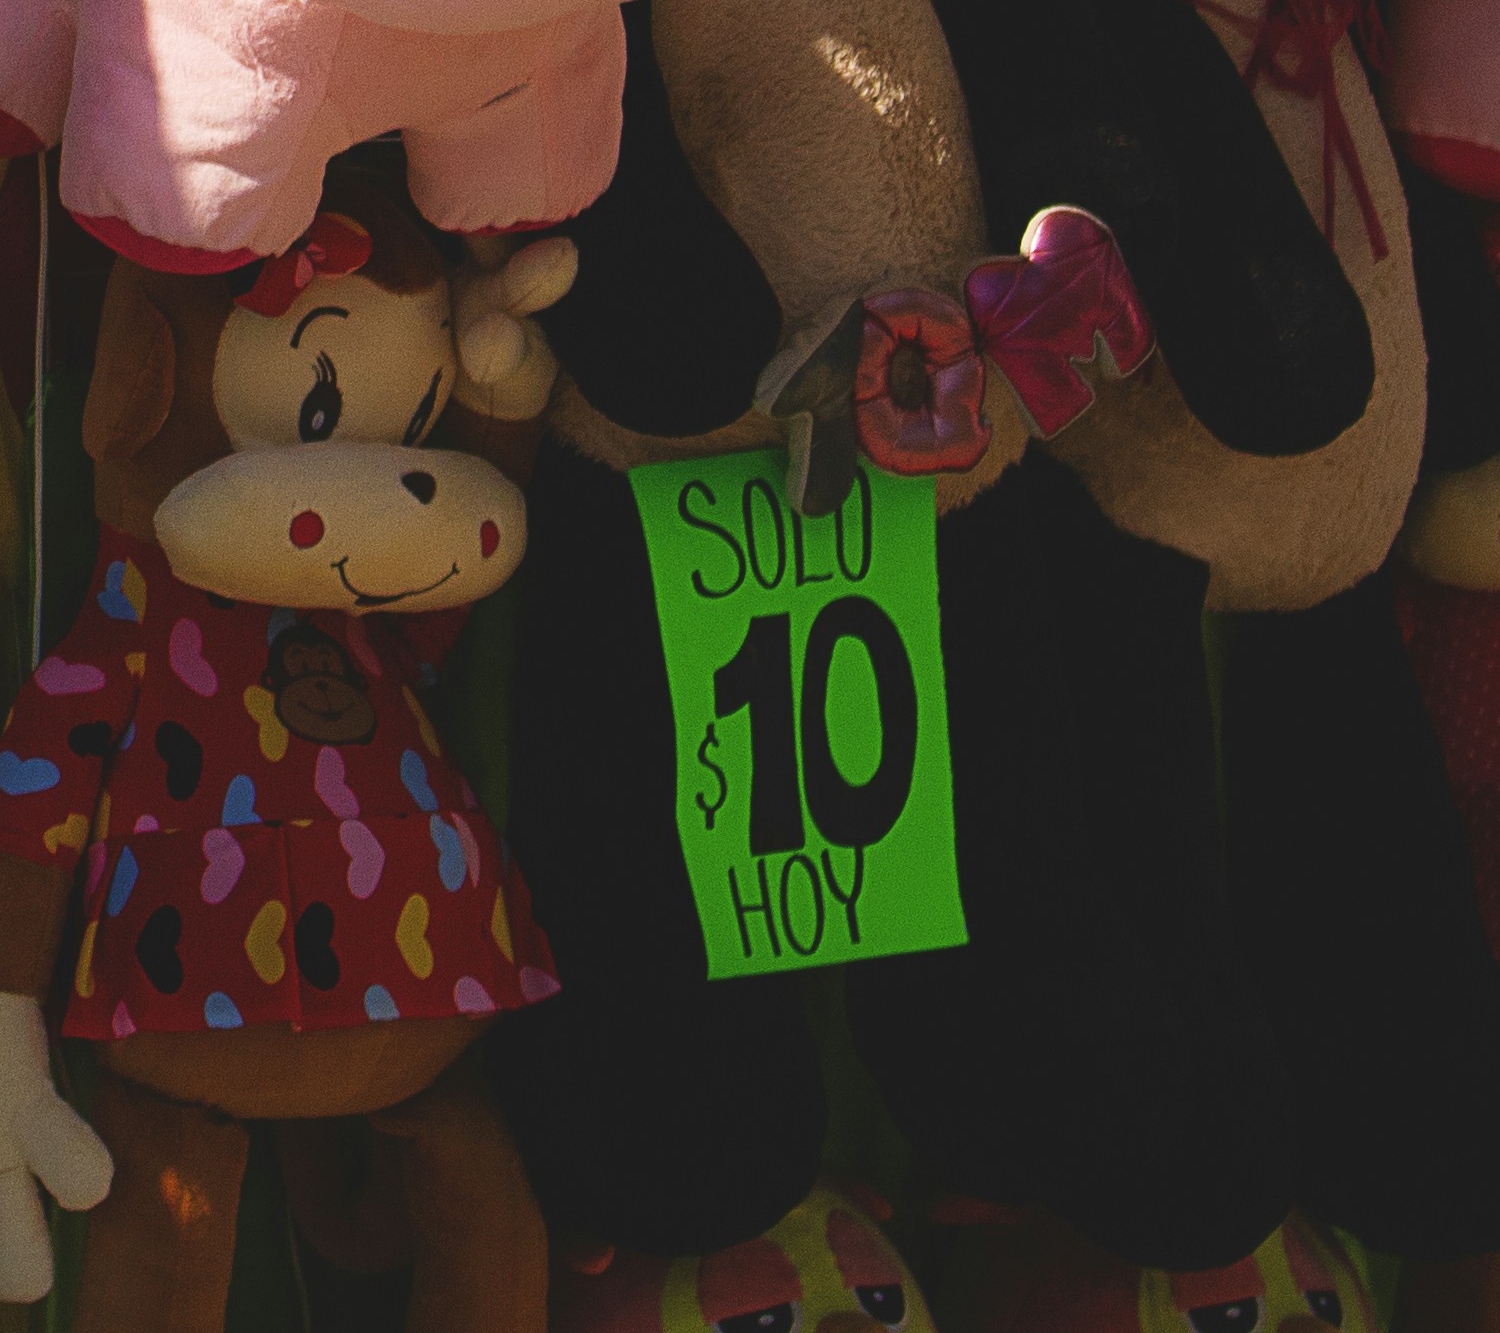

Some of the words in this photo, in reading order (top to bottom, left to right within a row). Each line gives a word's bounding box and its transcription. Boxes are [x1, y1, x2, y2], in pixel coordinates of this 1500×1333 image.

[678, 471, 873, 599] SOLO
[695, 595, 919, 856] $10
[728, 850, 865, 958] HOY
